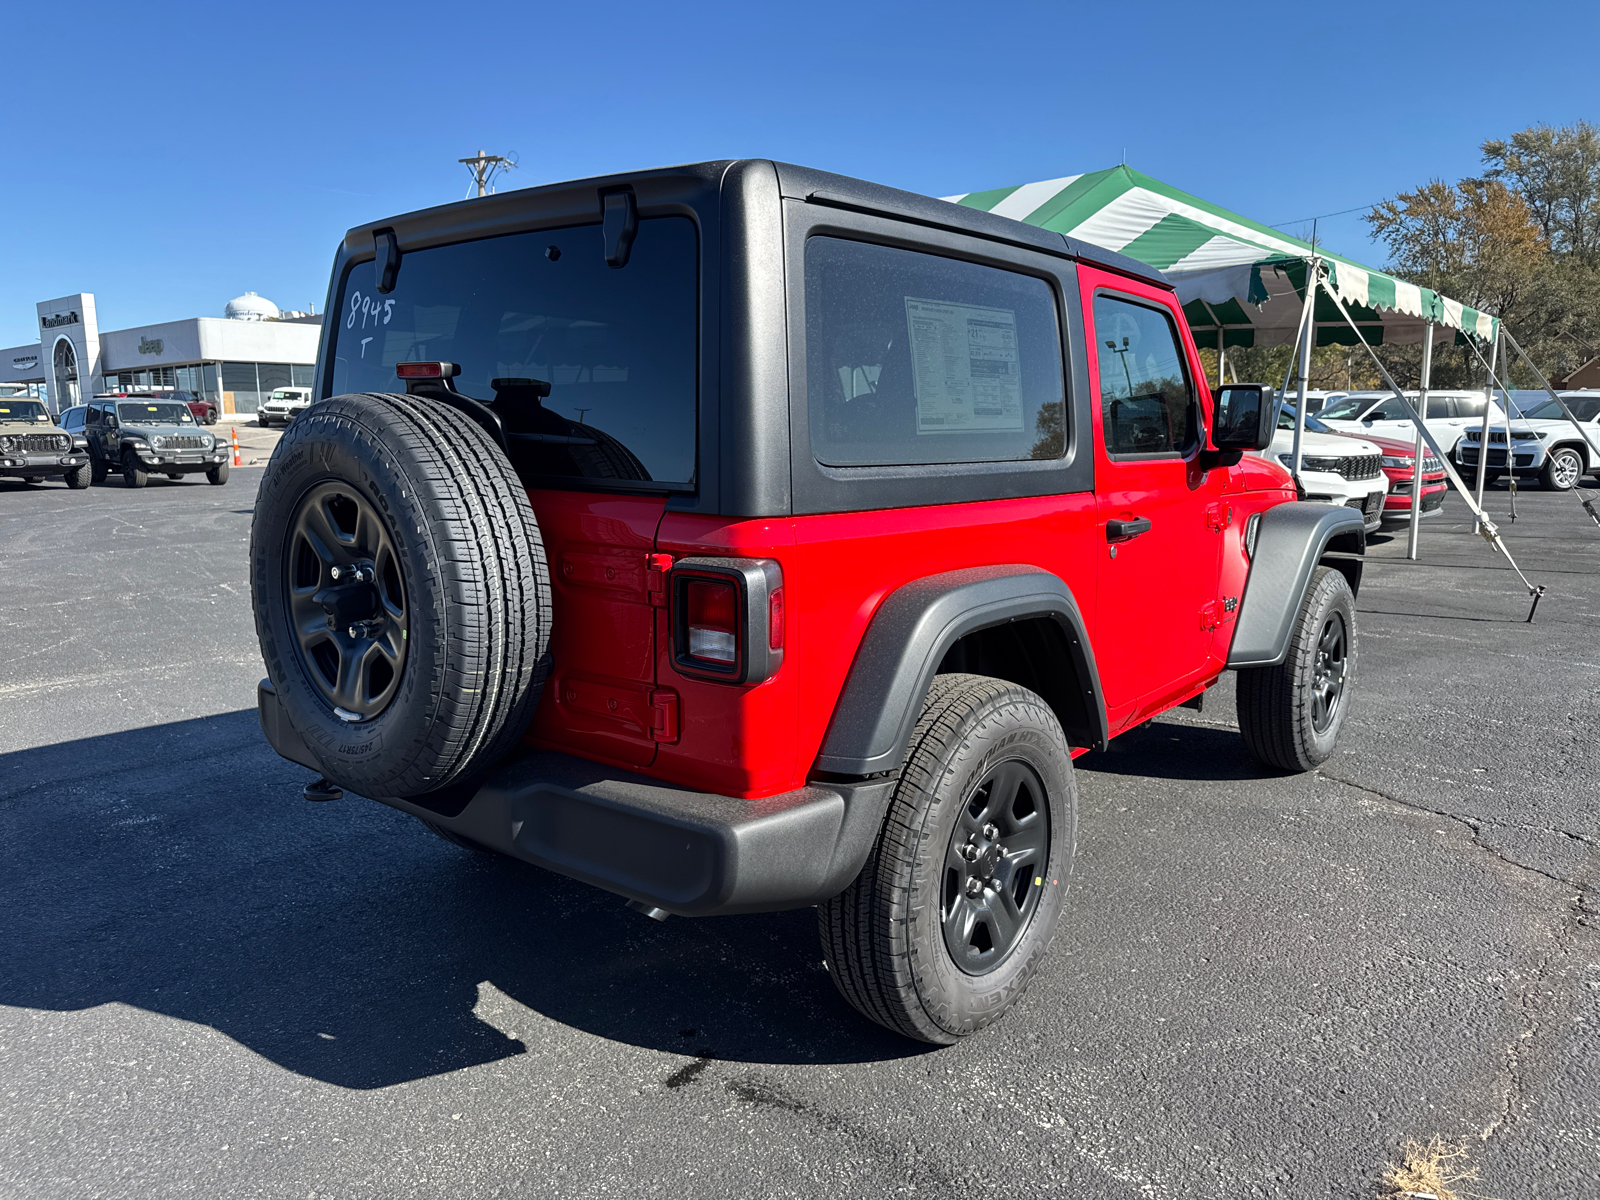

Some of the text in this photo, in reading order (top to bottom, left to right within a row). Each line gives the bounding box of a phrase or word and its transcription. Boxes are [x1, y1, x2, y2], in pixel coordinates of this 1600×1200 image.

[41, 312, 78, 328] Landmark
[347, 291, 396, 329] 8945
[138, 336, 163, 356] Jeep
[361, 337, 373, 358] T
[369, 480, 417, 604] ROADIAN
[256, 558, 288, 685] NEXEN
[338, 741, 373, 755] 245/75R17
[959, 732, 1017, 804] ROADIAN
[974, 948, 1038, 1010] NEXEN
